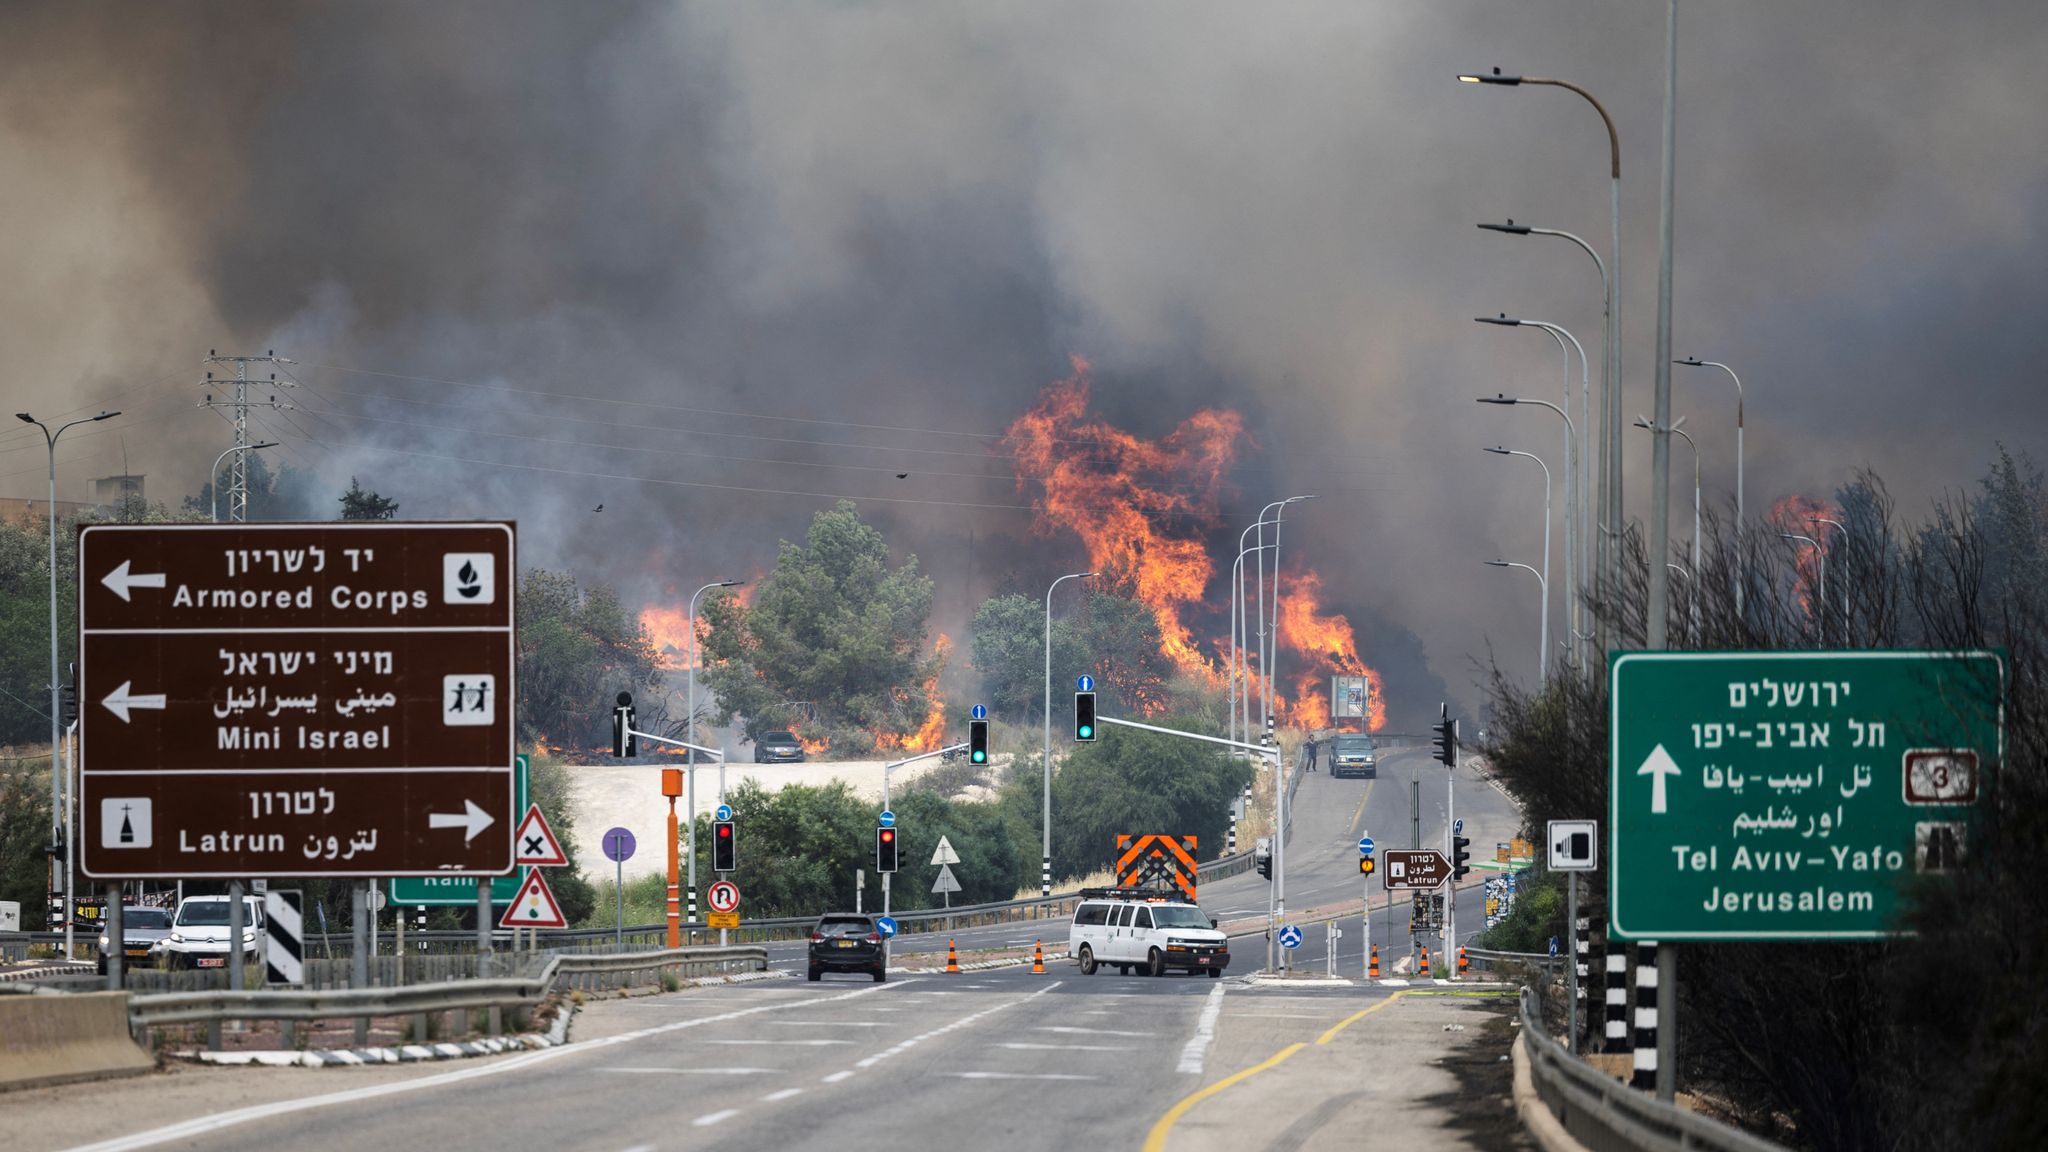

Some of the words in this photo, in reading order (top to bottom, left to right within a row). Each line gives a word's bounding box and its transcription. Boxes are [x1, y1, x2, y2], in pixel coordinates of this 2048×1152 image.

[225, 545, 325, 577] לשריון
[343, 548, 374, 572] יד
[172, 584, 313, 609] Armored
[331, 585, 428, 615] Corps
[219, 648, 316, 676] ישראל
[333, 651, 393, 675] מיני
[1728, 677, 1850, 708] ירושלים
[218, 726, 280, 750] Mini
[298, 725, 389, 750] Israel
[1848, 718, 1885, 748] תל
[1933, 766, 1949, 789] 3
[249, 787, 335, 819] לטרון
[180, 829, 285, 853] Latrun
[1671, 845, 1717, 871] Tel
[1407, 876, 1438, 884] Latrun
[1703, 886, 1873, 912] Jerusalem
